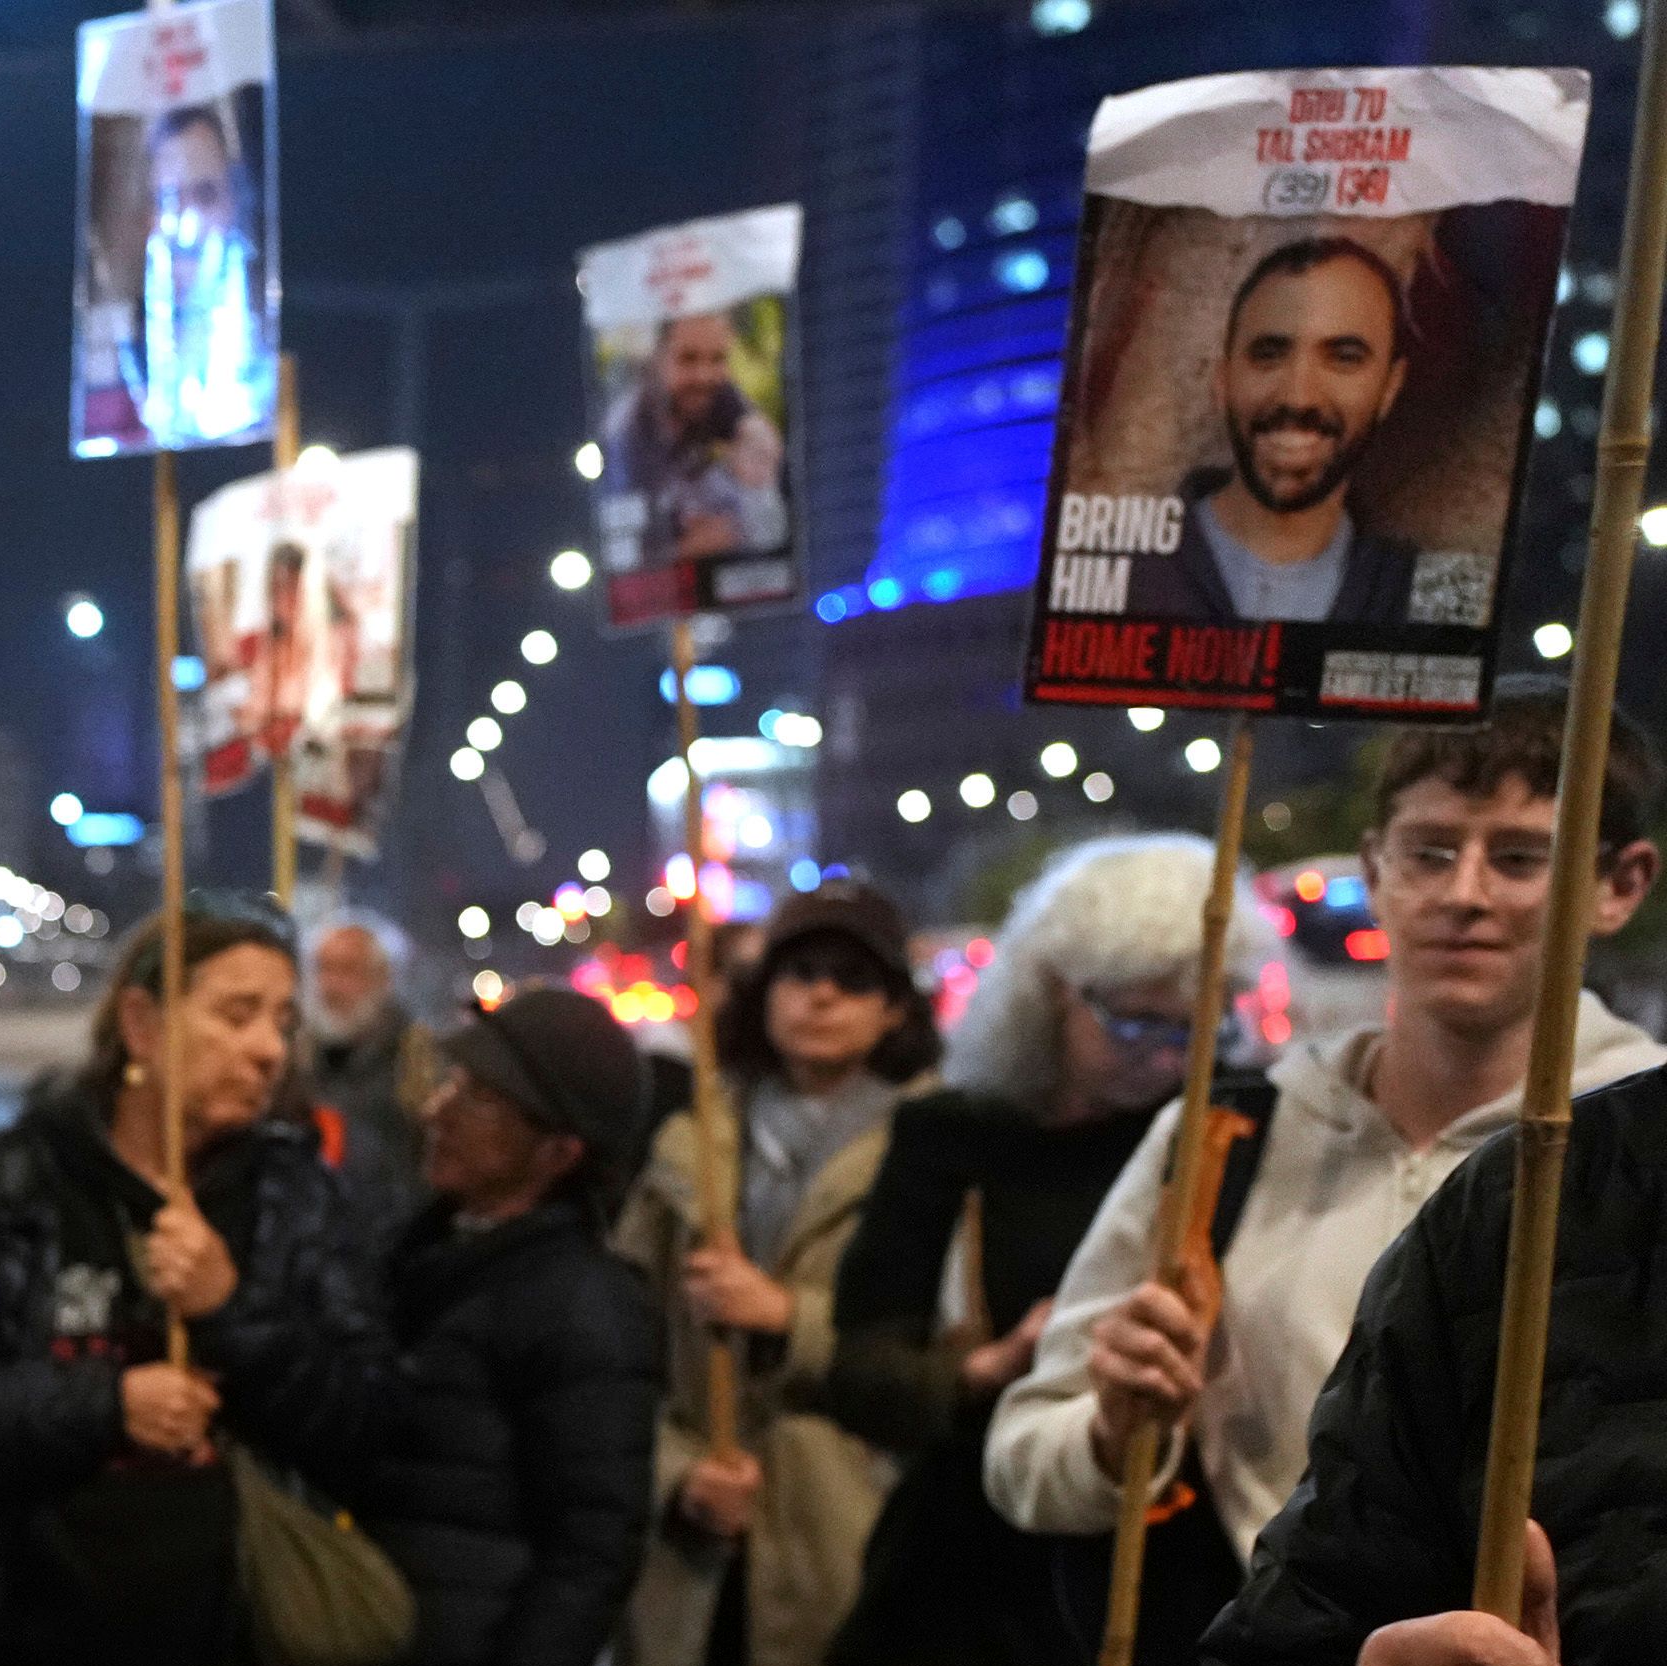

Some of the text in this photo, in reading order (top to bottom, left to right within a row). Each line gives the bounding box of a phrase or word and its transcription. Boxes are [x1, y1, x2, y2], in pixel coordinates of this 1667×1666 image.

[1255, 127, 1295, 165] TAL
[1056, 493, 1186, 555] BRING
[1047, 554, 1132, 614] HIM
[1042, 619, 1160, 681] HOME
[1167, 621, 1283, 688] NOW!
